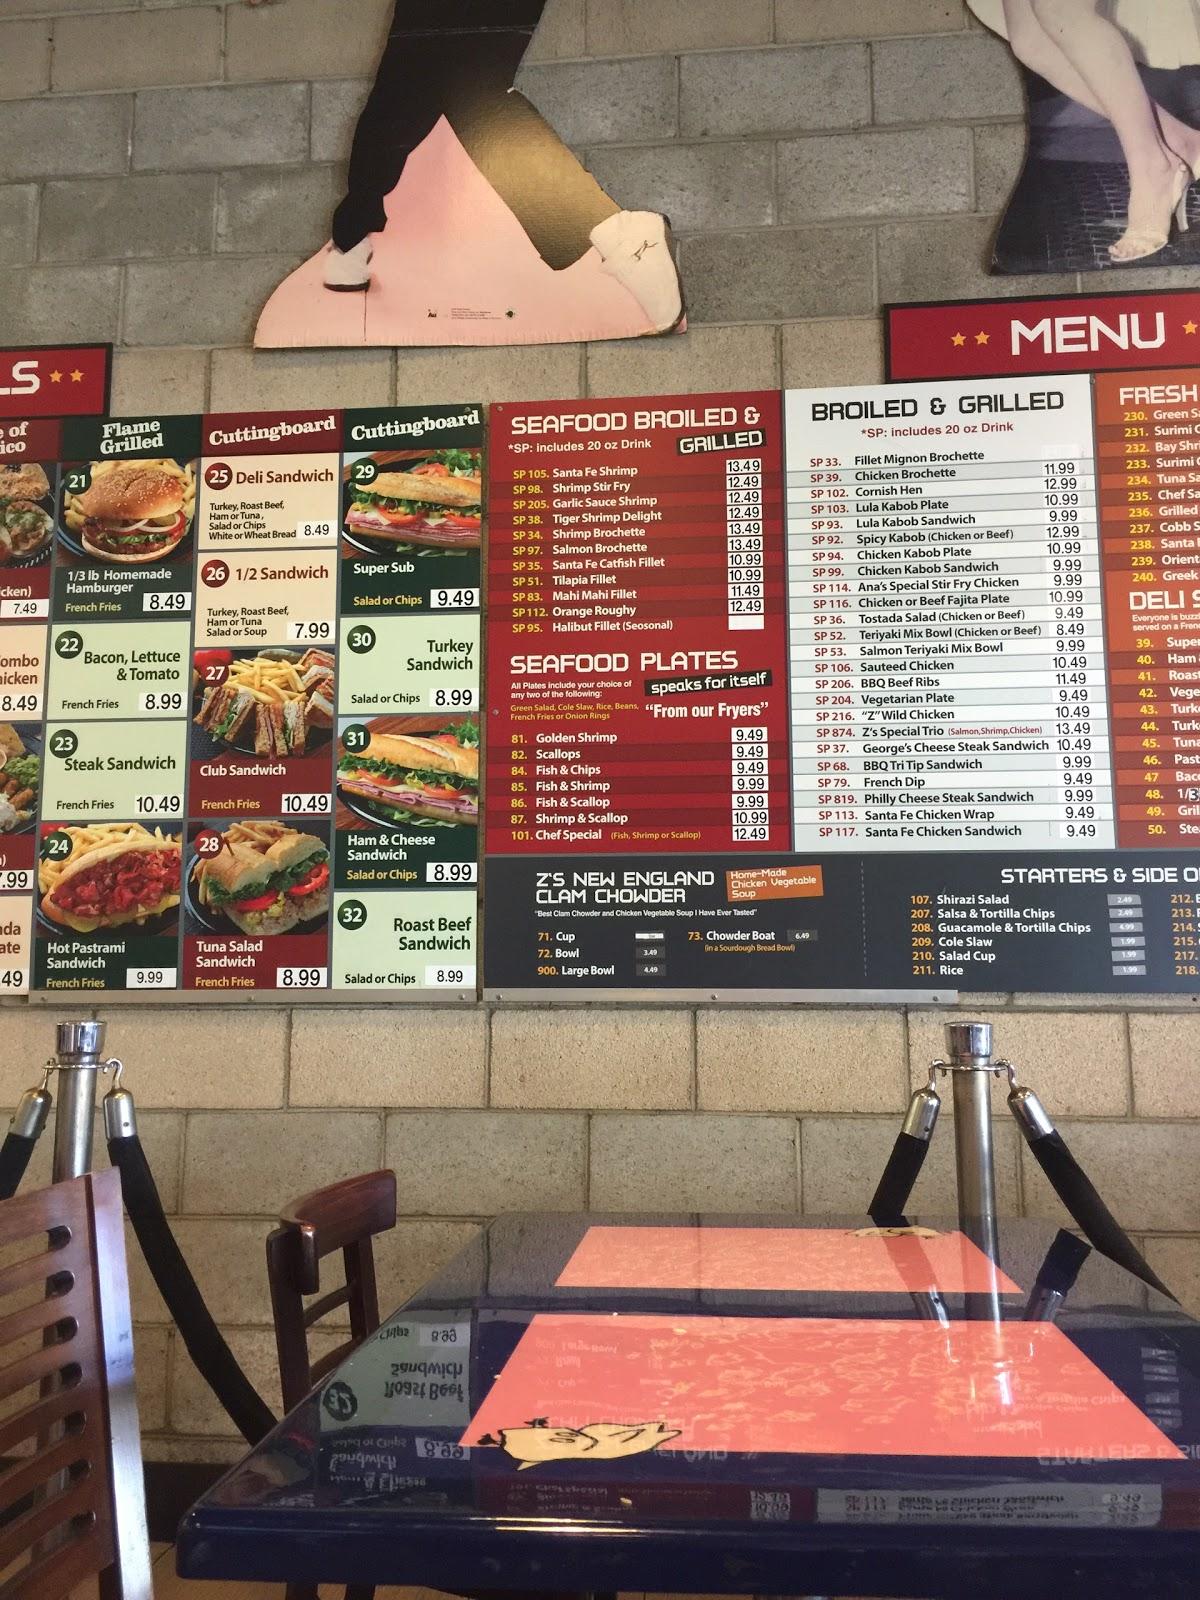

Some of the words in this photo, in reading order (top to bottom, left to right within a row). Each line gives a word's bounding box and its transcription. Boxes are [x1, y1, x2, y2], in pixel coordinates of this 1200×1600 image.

[1011, 312, 1165, 355] MENU
[1120, 384, 1198, 405] FRESH
[812, 399, 917, 421] BROILED
[930, 398, 946, 415] &
[959, 392, 1064, 414] GRILLED
[512, 413, 627, 434] SEAFOOD
[634, 408, 737, 429] BROILED
[744, 407, 760, 424] &
[1124, 411, 1148, 421] 230.
[1153, 410, 1189, 420] Green
[9, 421, 29, 437] of
[102, 421, 162, 441] Flame
[209, 416, 336, 445] Cuttingboard
[351, 410, 480, 440] Cuttingboard
[100, 433, 164, 454] Grilled
[537, 442, 584, 452] includes
[587, 441, 601, 450] 20
[621, 439, 651, 449] Drink
[680, 431, 762, 453] GRILLED
[810, 458, 823, 467] SP
[825, 458, 841, 466] 33.
[855, 455, 881, 465] Fillet
[884, 454, 927, 466] Mignon
[930, 451, 984, 462] Brochette
[210, 470, 228, 483] 25
[236, 471, 264, 484] Deli
[266, 468, 333, 483] Sandwich
[513, 470, 526, 479] SP
[528, 470, 549, 478] 105.
[553, 468, 583, 477] Santa
[585, 467, 597, 476] Fe
[599, 466, 638, 477] Shrimp
[1044, 463, 1075, 475] 11.99
[69, 475, 85, 488] 21
[728, 476, 759, 488] 12.49
[209, 532, 233, 540] White
[244, 531, 271, 539] Wheat
[272, 530, 296, 538] Bread
[304, 524, 329, 537] 8.49
[68, 571, 85, 581] 1/3
[88, 570, 99, 580] lb
[104, 568, 172, 580] Homemade
[206, 567, 225, 580] 26
[236, 568, 257, 581] 1/2
[261, 565, 328, 580] Sandwich
[1054, 574, 1082, 586] 9.99
[67, 582, 133, 595] Hamburger
[813, 584, 826, 593] SP
[829, 584, 851, 592] 114.
[890, 580, 929, 593] Special
[932, 579, 951, 589] Stir
[954, 579, 971, 591] Fry
[974, 577, 1019, 588] Chicken
[149, 595, 186, 610] 8.49
[1129, 590, 1185, 610] DELI
[295, 623, 330, 639] 7.99
[513, 624, 525, 633] SP
[527, 624, 543, 632] 95.
[553, 622, 592, 632] Halibut
[594, 621, 620, 631] Fillet
[60, 638, 78, 652] 22
[352, 633, 371, 646] 30
[427, 639, 473, 655] Turkey
[84, 651, 128, 665] Bacon,
[132, 650, 180, 663] Lettuce
[407, 656, 473, 671] Sandwich
[511, 653, 629, 674] SEAFOOD
[641, 651, 738, 671] PLATES
[117, 668, 127, 681] &
[129, 668, 180, 680] Tomato
[652, 679, 702, 696] speaks
[705, 677, 727, 689] for
[730, 672, 767, 687] itself
[146, 694, 182, 709] 8.99
[436, 690, 473, 705] 8.99
[692, 706, 714, 717] our
[347, 732, 364, 746] 31
[512, 735, 527, 743] 81.
[536, 733, 575, 743] Golden
[578, 732, 617, 744] Shrimp
[736, 730, 763, 741] 9.49
[55, 737, 73, 751] 23
[65, 757, 104, 771] Steak
[107, 756, 175, 770] Sandwich
[137, 796, 180, 812] 10.49
[819, 827, 832, 837] SP
[835, 827, 858, 836] 117.
[866, 827, 898, 837] Santa
[901, 827, 914, 837] Fe
[916, 826, 962, 836] Chicken
[965, 825, 1021, 836] Sandwich
[1067, 825, 1096, 837] 9.49
[49, 840, 68, 854] 24
[200, 837, 219, 852] 28
[348, 835, 376, 846] Ham
[379, 834, 389, 845] &
[391, 834, 435, 845] Cheese
[348, 848, 407, 861] Sandwich
[434, 864, 472, 881] 8.99
[573, 872, 615, 886] NEW
[624, 871, 714, 886] ENGLAND
[1001, 868, 1108, 883] STARTERS
[1113, 868, 1127, 883] &
[1132, 868, 1178, 882] SIDE
[732, 880, 767, 889] Chicken
[771, 876, 816, 888] Vegetable
[536, 889, 586, 903] CLAM
[595, 888, 685, 903] CHOWDER
[732, 890, 756, 899] Soup
[911, 895, 932, 904] 107.
[937, 895, 975, 904] Shirazi
[978, 894, 1009, 904] Salad
[343, 908, 362, 922] 32
[643, 910, 675, 918] Vegetable
[676, 909, 694, 917] Soup
[394, 918, 435, 931] Roast
[438, 917, 472, 931] Beef
[48, 943, 70, 953] Hot
[72, 942, 125, 953] Pastrami
[196, 941, 226, 952] Tuna
[229, 940, 263, 952] Salad
[399, 935, 470, 950] Sandwich
[47, 957, 105, 969] Sandwich
[196, 955, 255, 967] Sandwich
[437, 970, 463, 983] 8.99
[538, 966, 558, 975] 900.
[562, 966, 589, 977] Large
[591, 965, 614, 975] Bowl
[913, 966, 935, 975] 211.
[940, 965, 963, 975] Rice
[137, 971, 163, 985] 9.99
[282, 970, 320, 987] 8.99
